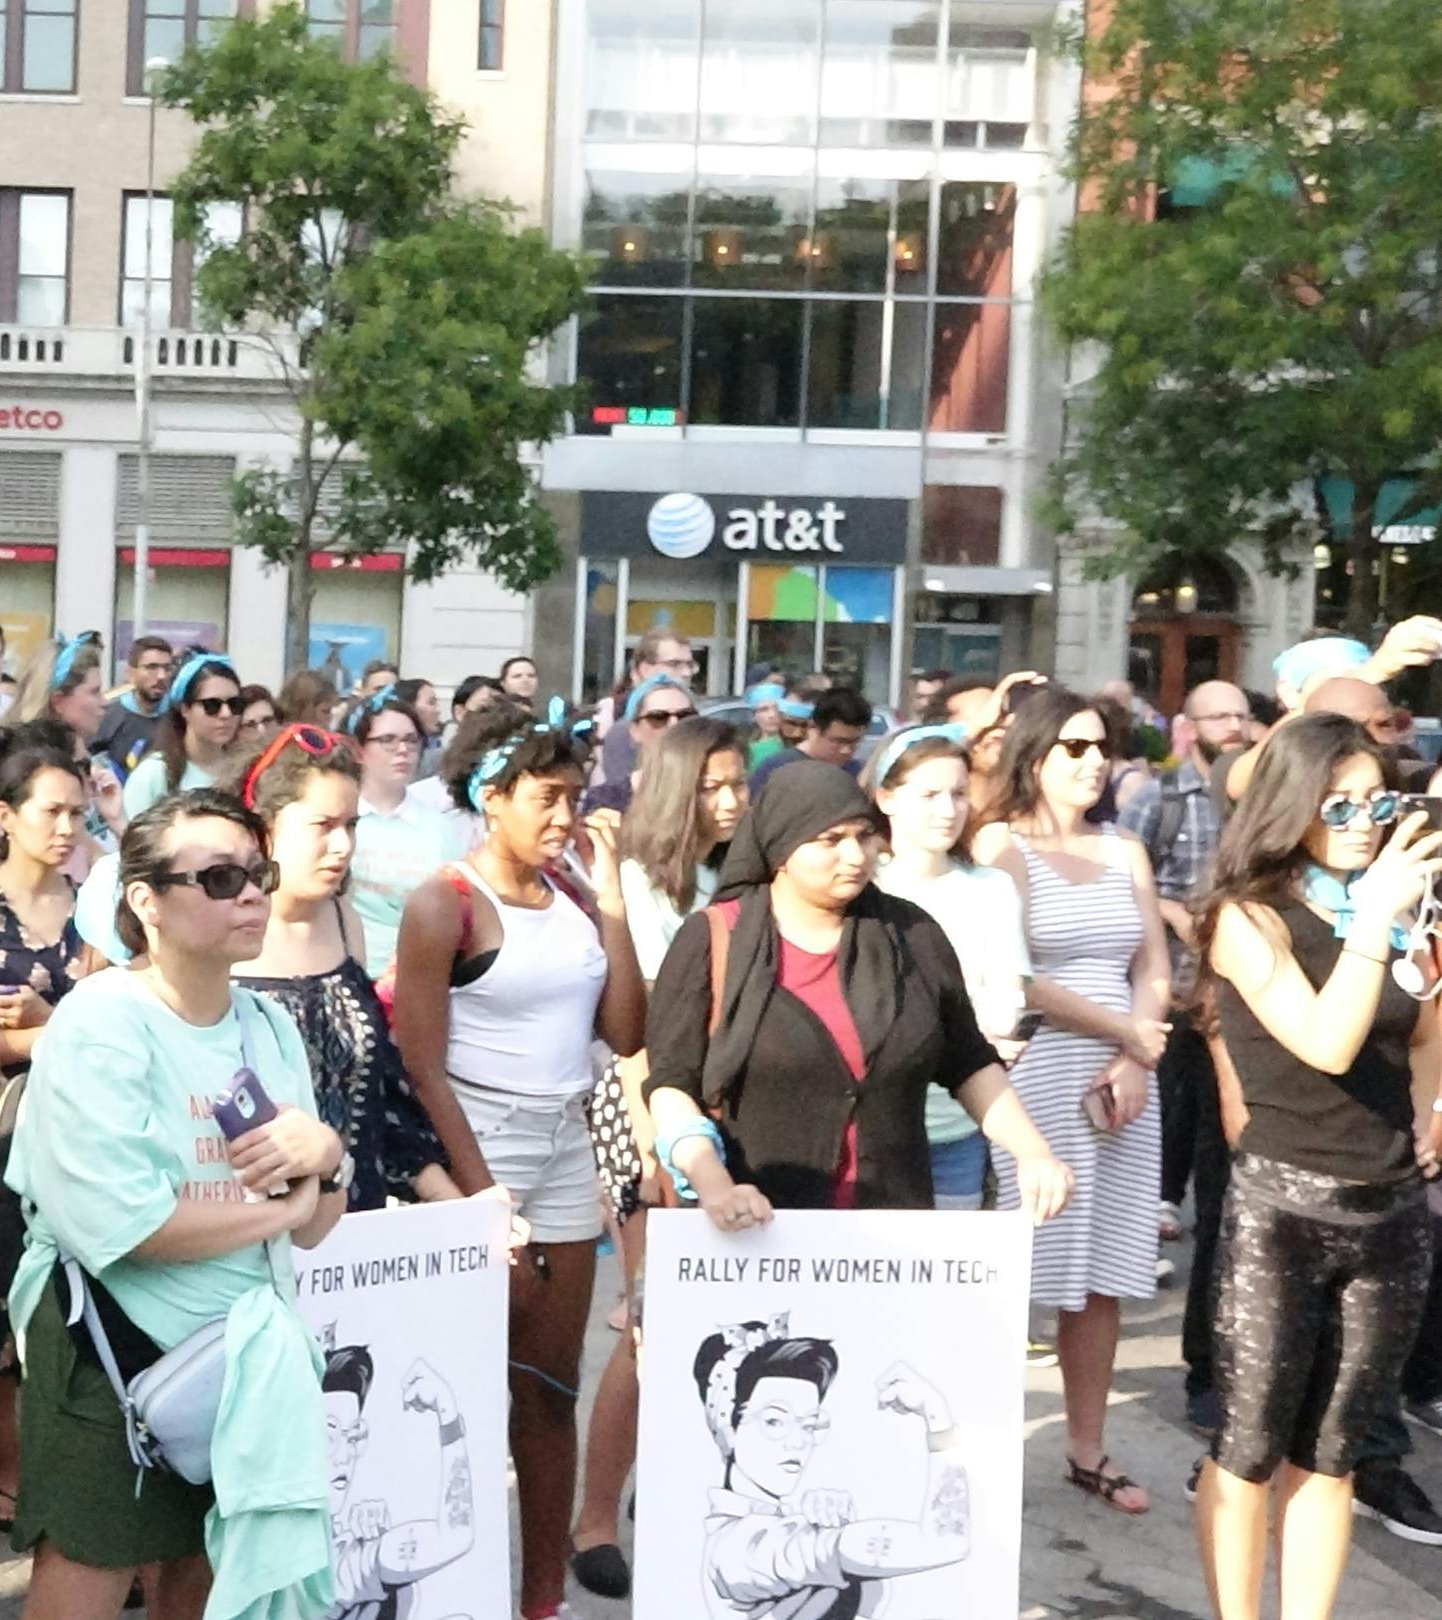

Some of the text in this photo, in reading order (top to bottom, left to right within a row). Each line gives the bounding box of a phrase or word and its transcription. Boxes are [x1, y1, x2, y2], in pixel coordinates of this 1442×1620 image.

[722, 499, 846, 552] at&t
[310, 1264, 345, 1295] FOR
[351, 1254, 419, 1289] WOMEN
[424, 1250, 442, 1277] IN
[448, 1243, 489, 1274] TECH
[677, 1257, 998, 1284] RALLY FOR WOMEN IN TECH
